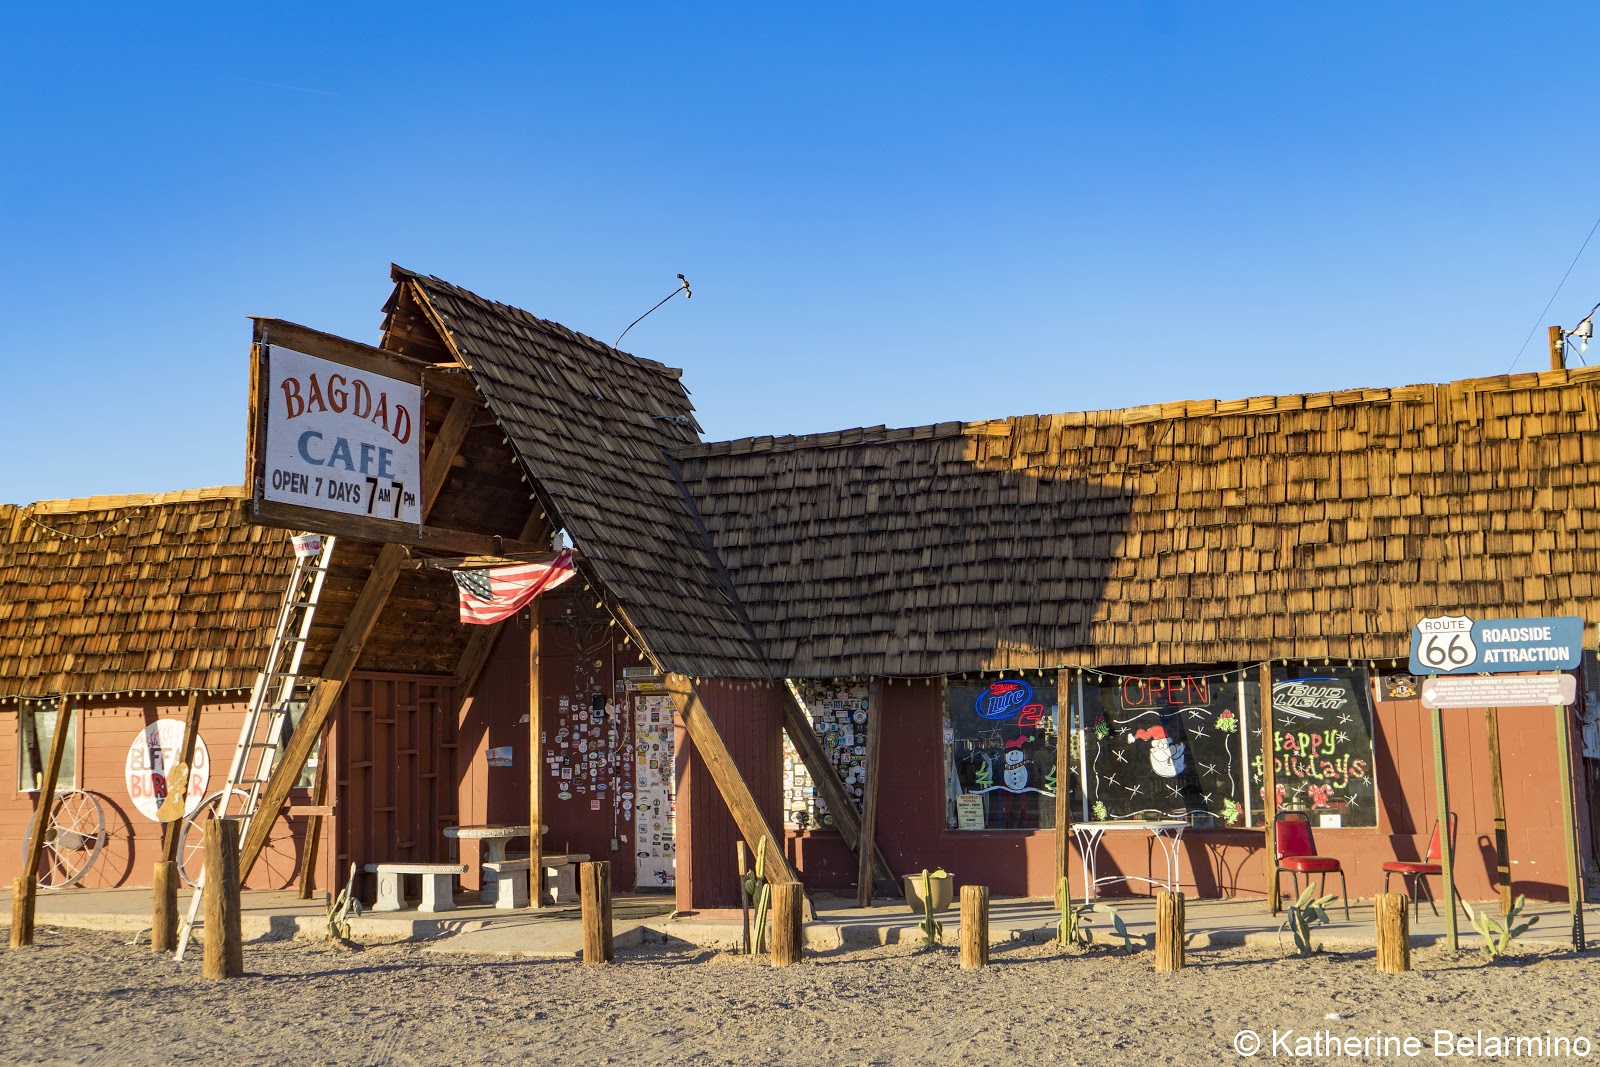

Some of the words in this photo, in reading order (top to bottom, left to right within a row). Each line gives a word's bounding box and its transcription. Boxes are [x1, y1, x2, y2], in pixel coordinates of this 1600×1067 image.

[280, 373, 411, 444] BAGDAD
[297, 430, 396, 479] CAFE
[272, 468, 309, 495] OPEN
[315, 477, 323, 497] 7
[328, 479, 361, 504] DAYS
[1425, 620, 1466, 631] ROUTE
[1482, 626, 1552, 643] ROADSIDE
[1426, 633, 1469, 666] 66
[1483, 646, 1570, 664] ATTRACTION
[989, 683, 1018, 695] Miller
[1123, 674, 1209, 706] OPEN
[1273, 693, 1348, 710] LIGHT
[1287, 685, 1346, 699] BUD
[985, 689, 1025, 717] Lite
[1017, 703, 1044, 727] 2
[130, 746, 205, 771] BUFFAO
[131, 772, 204, 799] BURR
